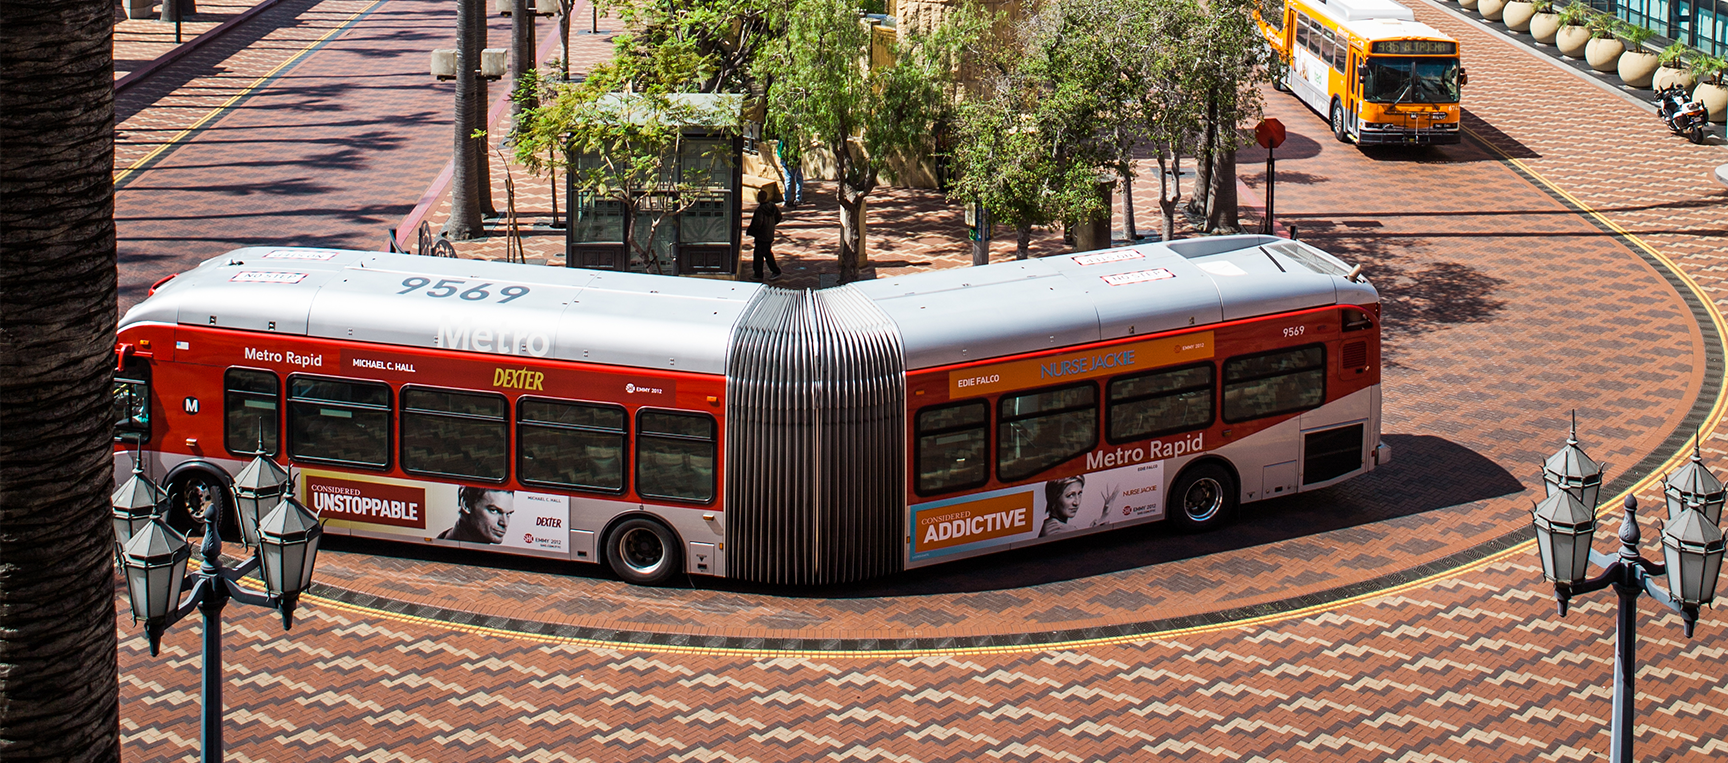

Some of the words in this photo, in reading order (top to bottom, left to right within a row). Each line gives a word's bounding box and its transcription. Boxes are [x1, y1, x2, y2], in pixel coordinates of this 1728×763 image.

[396, 276, 532, 304] 9569
[437, 314, 550, 358] Metro
[1283, 325, 1305, 338] 9569
[244, 347, 283, 362] Metro
[286, 351, 323, 368] Rapid
[352, 358, 387, 370] MICHAEL
[387, 361, 395, 371] C.
[395, 362, 416, 373] HALL
[1040, 357, 1087, 379] NURSE
[1089, 349, 1136, 372] JACKIE
[492, 366, 545, 391] DEXTER
[957, 377, 975, 388] EDIE
[976, 374, 1000, 386] FALCO
[185, 398, 198, 413] M
[1086, 447, 1144, 471] Metro
[1150, 432, 1204, 459] Rapid
[311, 483, 361, 496] CONSIDERED
[1122, 488, 1140, 497] NURSE
[313, 492, 418, 521] UNSTOPPABLE
[536, 516, 562, 528] DEXTER
[921, 510, 971, 526] CONSIDERED
[923, 507, 1027, 544] ADDICTIVE
